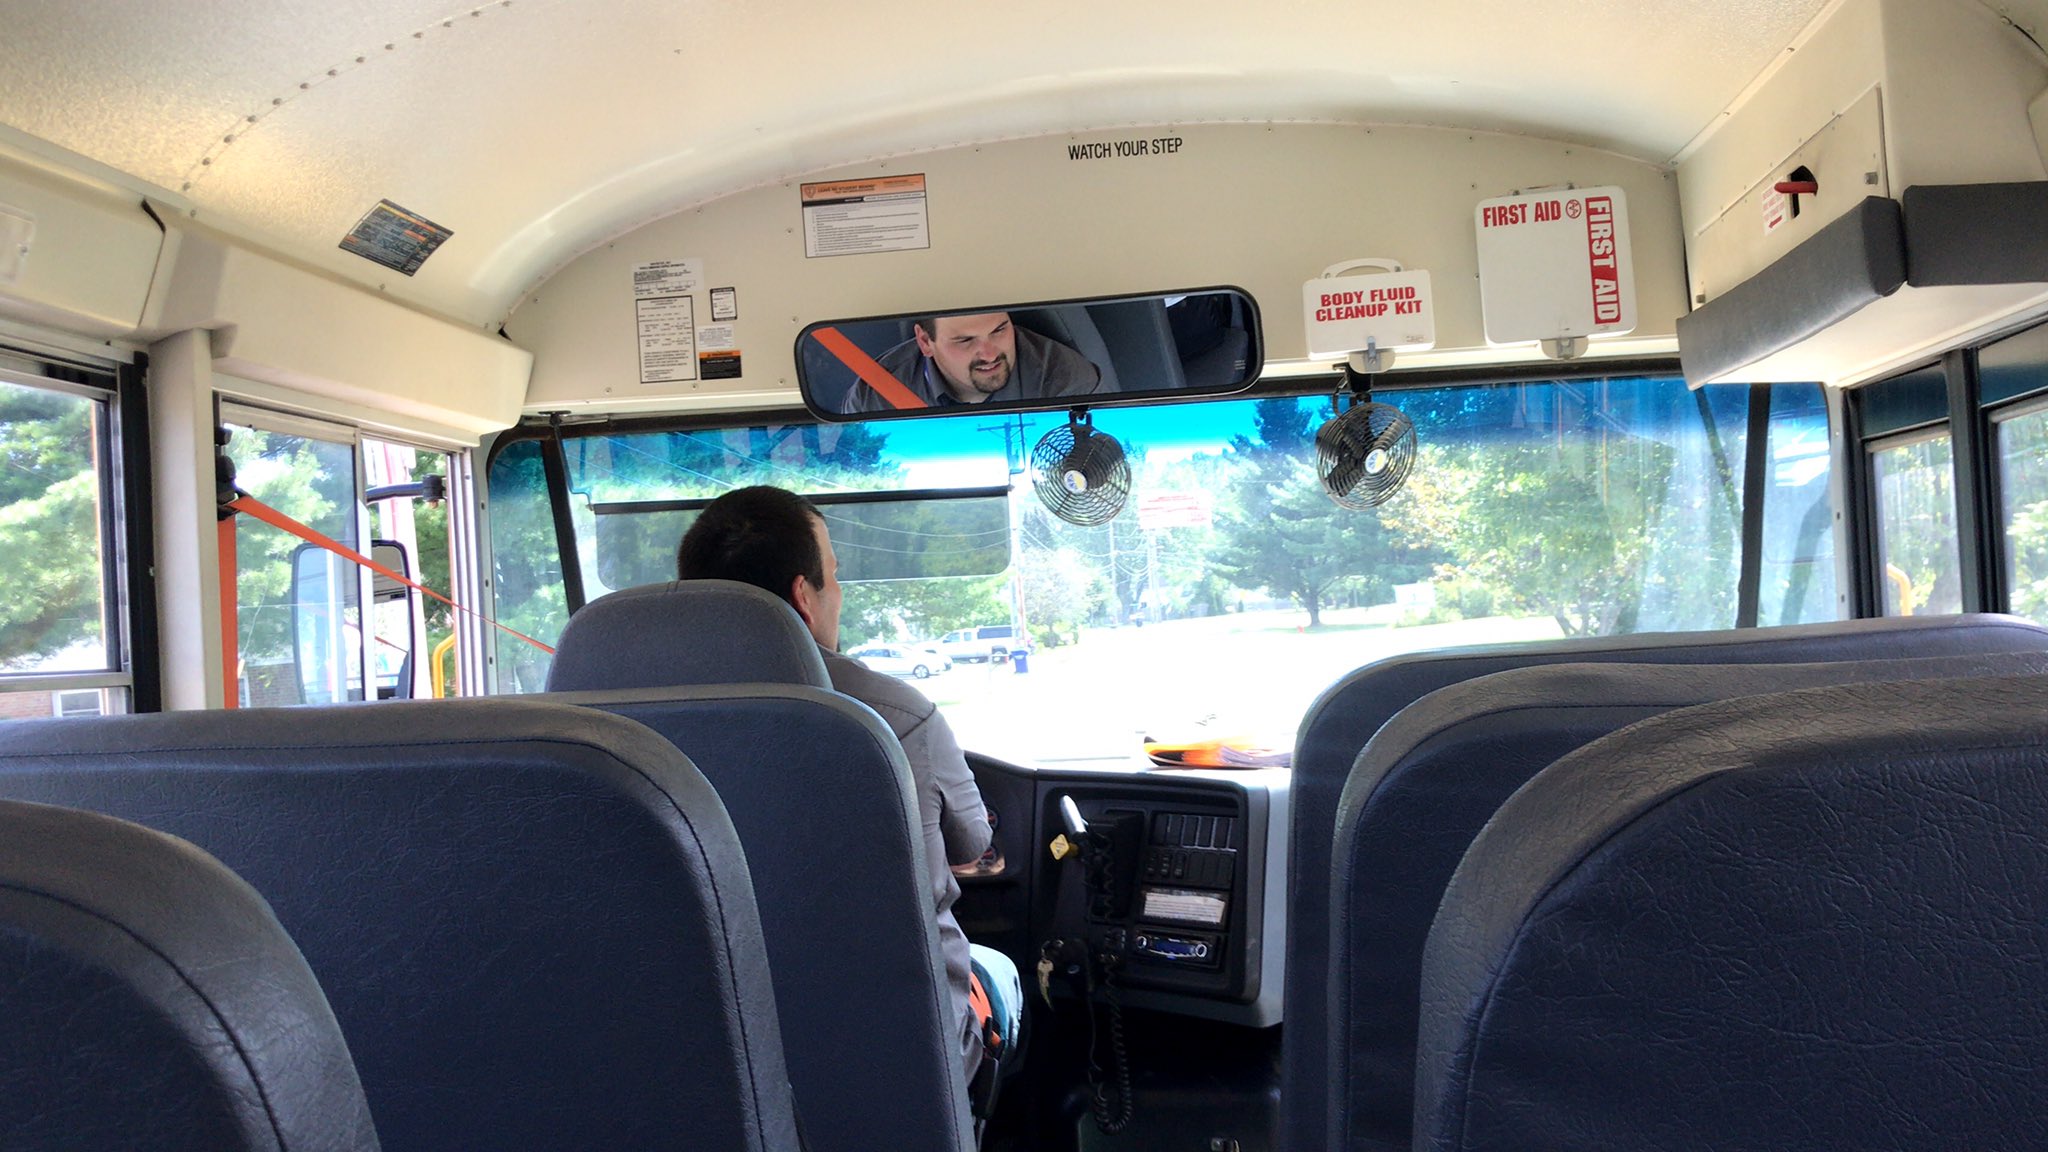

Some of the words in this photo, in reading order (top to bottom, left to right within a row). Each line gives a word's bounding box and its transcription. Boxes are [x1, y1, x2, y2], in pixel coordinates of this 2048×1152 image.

[1068, 142, 1111, 160] WATCH
[1114, 140, 1148, 157] YOUR
[1152, 137, 1183, 154] STEP
[1483, 203, 1527, 227] FIRST
[1534, 200, 1561, 222] AID
[1588, 199, 1616, 269] FIRST
[1320, 290, 1364, 307] BODY
[1370, 286, 1416, 302] FLUID
[1594, 278, 1619, 320] AID
[1315, 303, 1388, 322] CLEANUP
[1395, 300, 1422, 315] KIT
